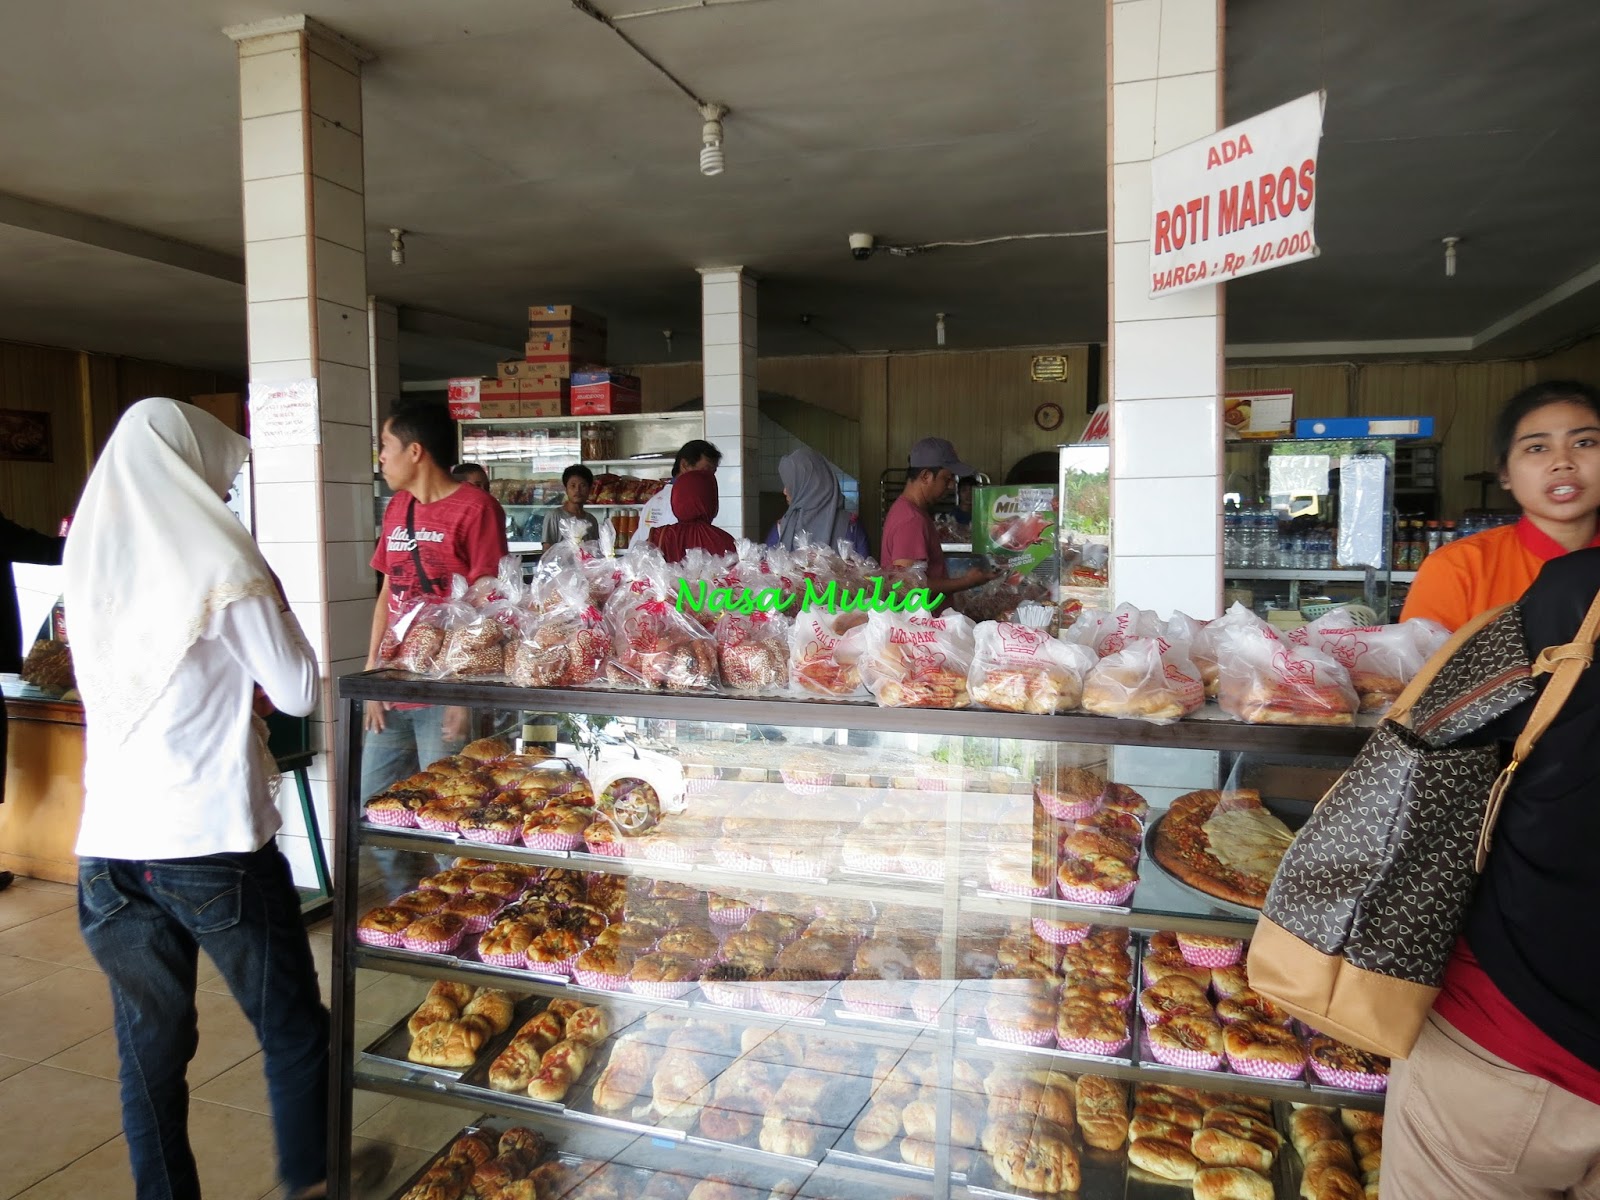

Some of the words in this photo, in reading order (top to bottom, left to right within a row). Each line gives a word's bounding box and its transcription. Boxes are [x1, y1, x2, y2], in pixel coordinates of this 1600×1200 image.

[1207, 134, 1253, 170] ADA
[1154, 195, 1210, 255] ROTI
[1217, 158, 1315, 236] MAROS
[1152, 261, 1207, 292] HARGA
[1221, 253, 1245, 276] Rp
[996, 502, 1020, 513] MIL
